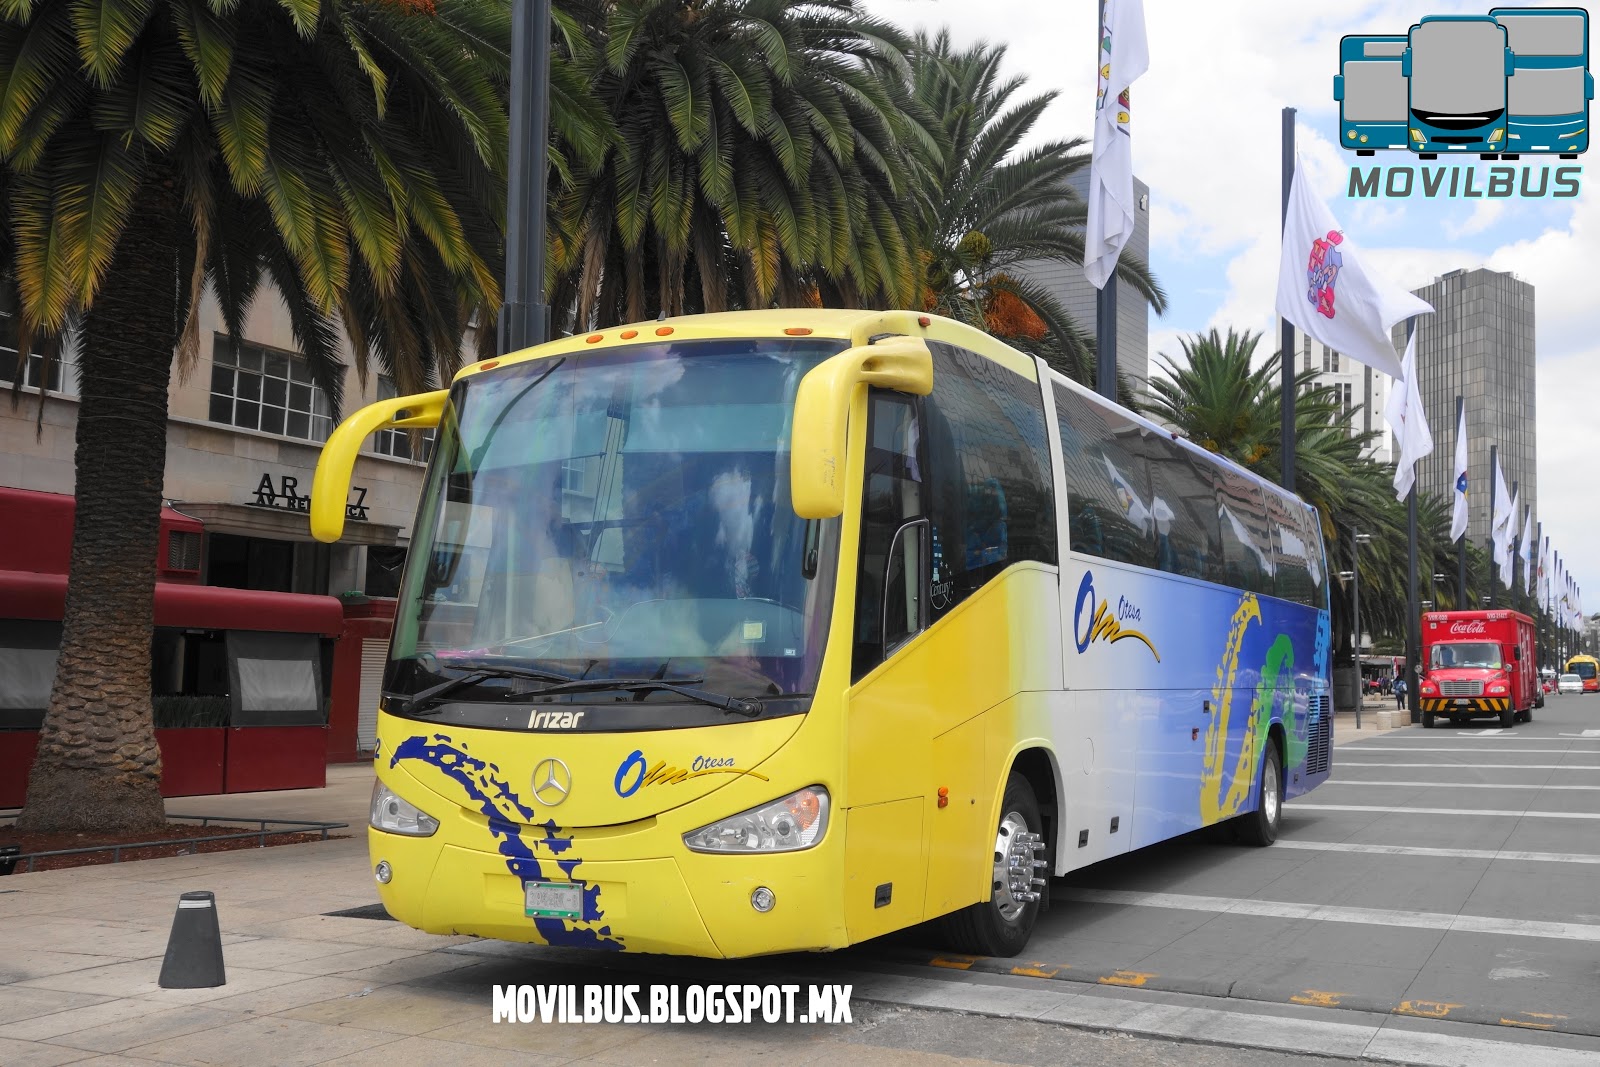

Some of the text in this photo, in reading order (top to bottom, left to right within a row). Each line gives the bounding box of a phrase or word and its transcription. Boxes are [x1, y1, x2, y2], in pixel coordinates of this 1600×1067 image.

[1118, 594, 1141, 622] Otesa
[528, 710, 584, 728] Irizar
[692, 755, 735, 772] Otesa
